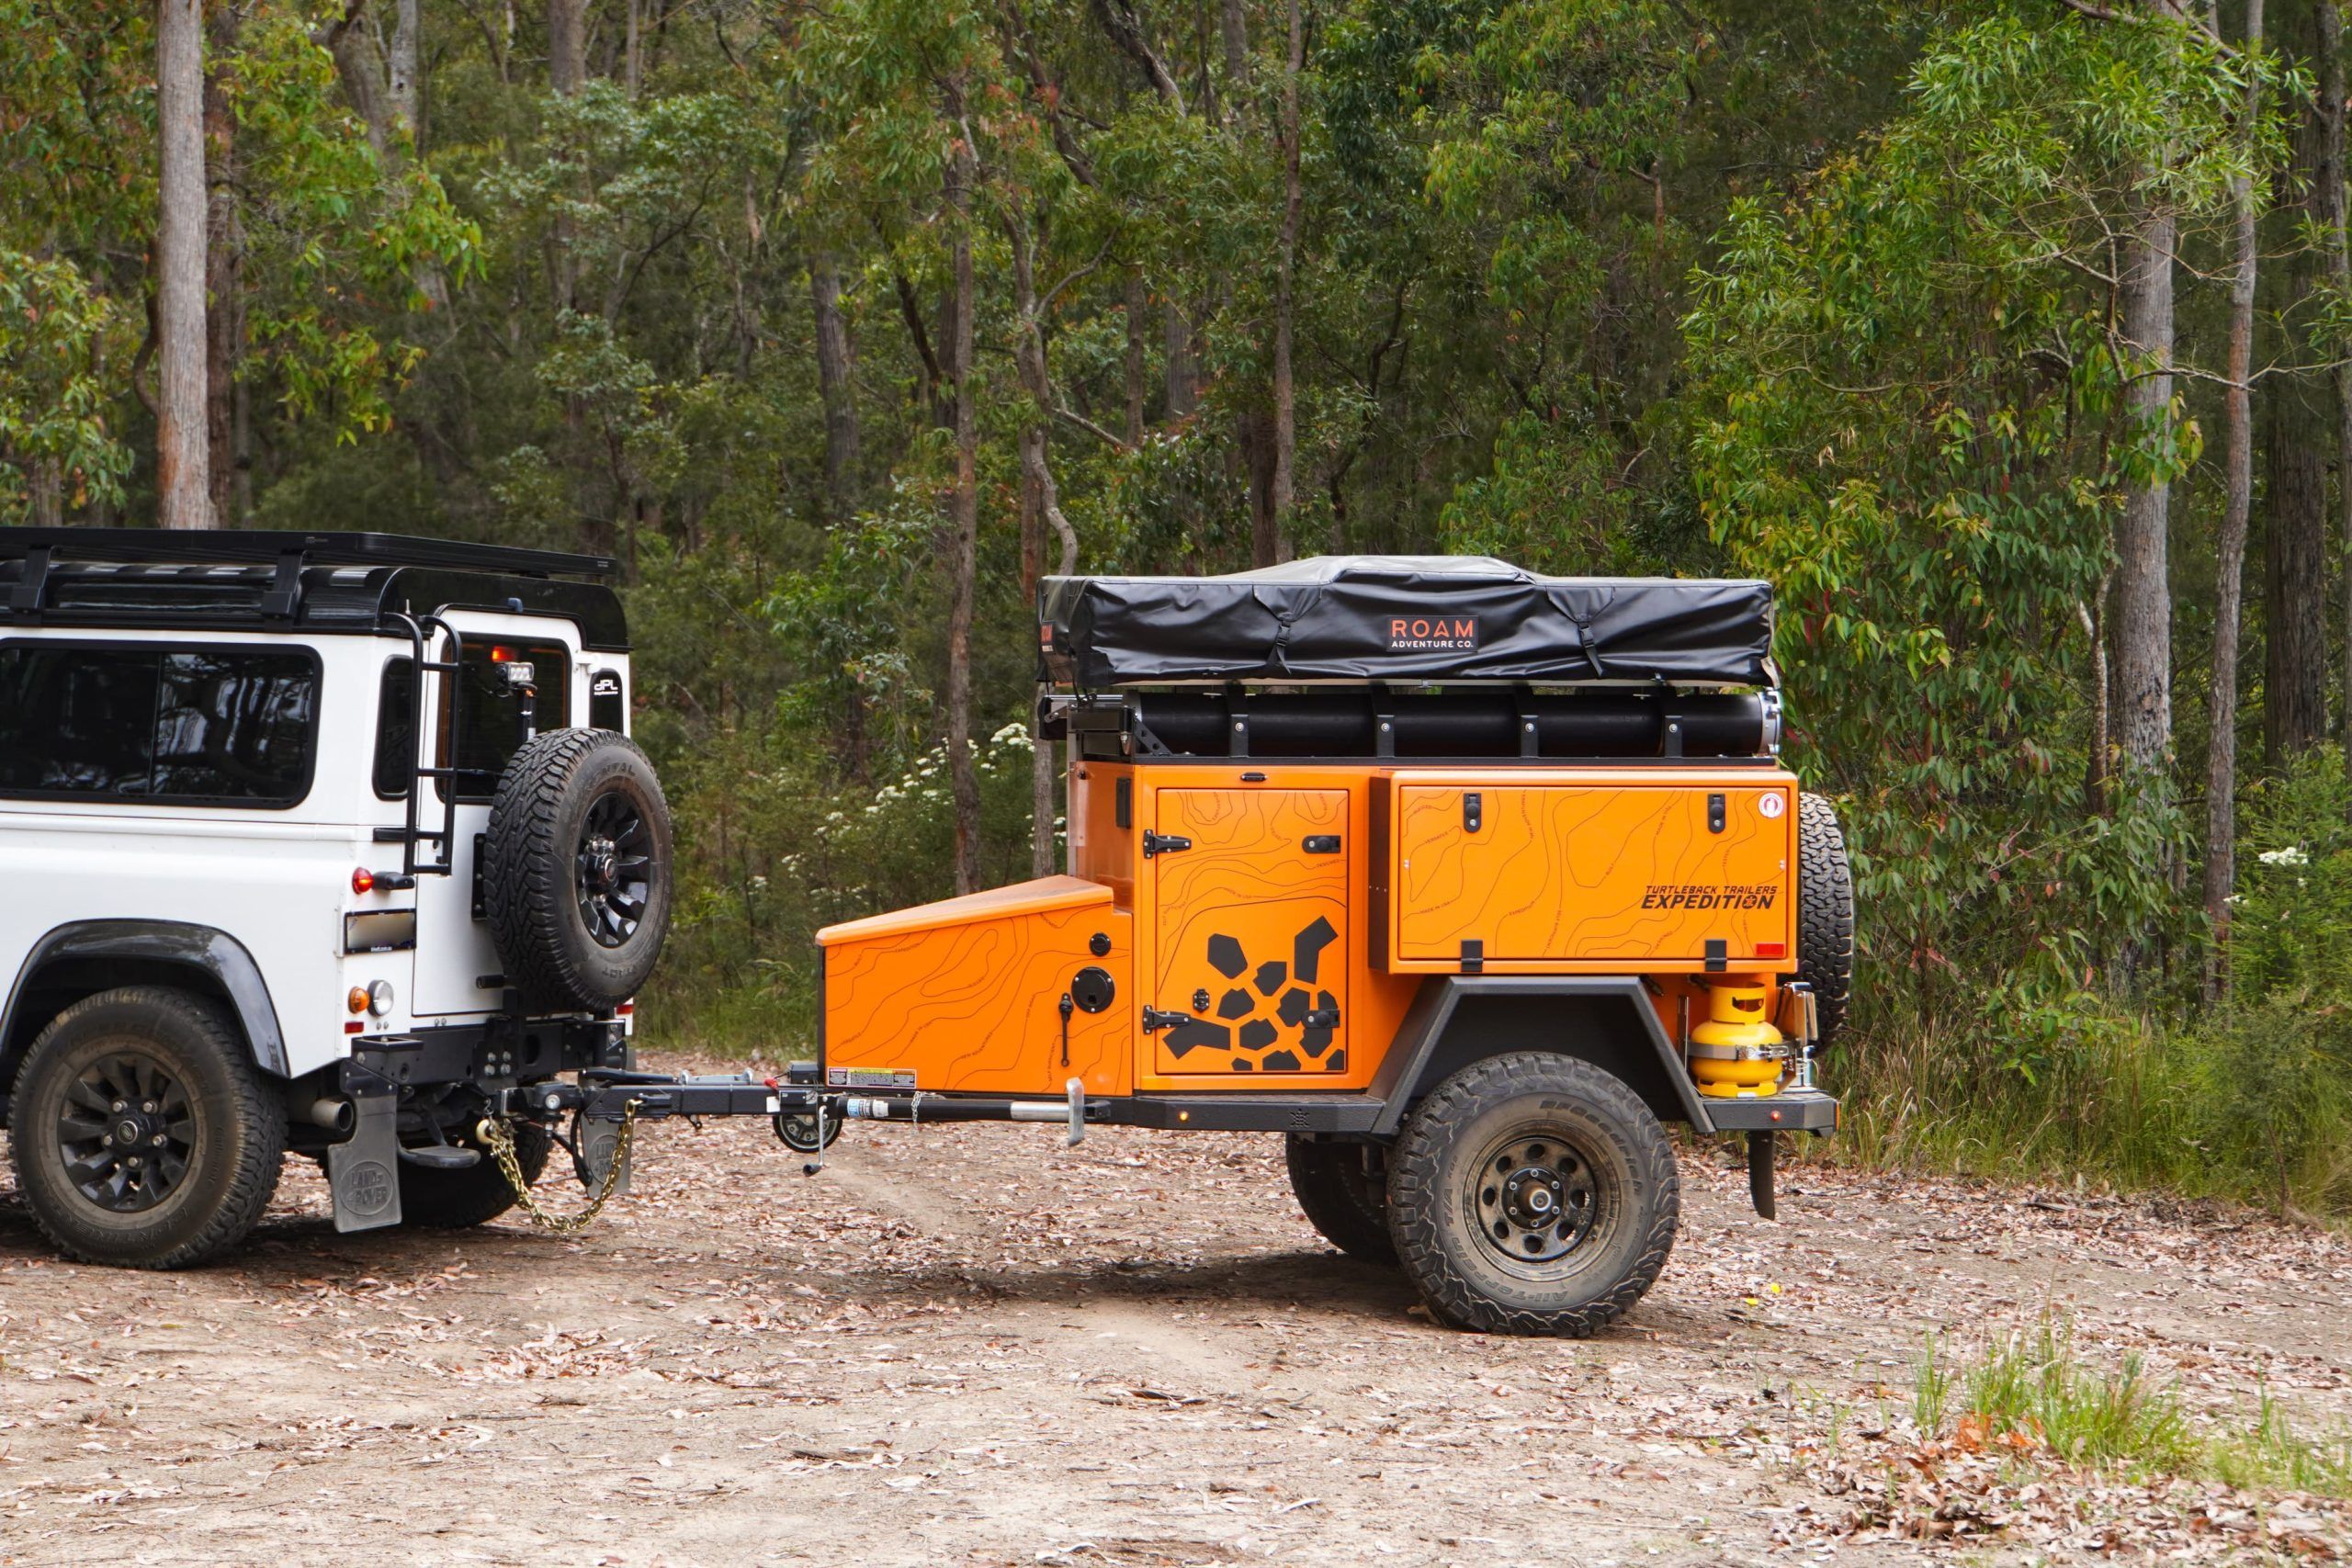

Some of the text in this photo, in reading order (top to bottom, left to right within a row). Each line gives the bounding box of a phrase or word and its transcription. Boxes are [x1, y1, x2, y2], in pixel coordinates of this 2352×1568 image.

[1391, 619, 1474, 638] ROAM
[1391, 640, 1474, 649] ADVENTURE CO.
[1645, 886, 1778, 895] TURTLEBACK TRAILERS
[1641, 894, 1774, 909] EXPEDITION
